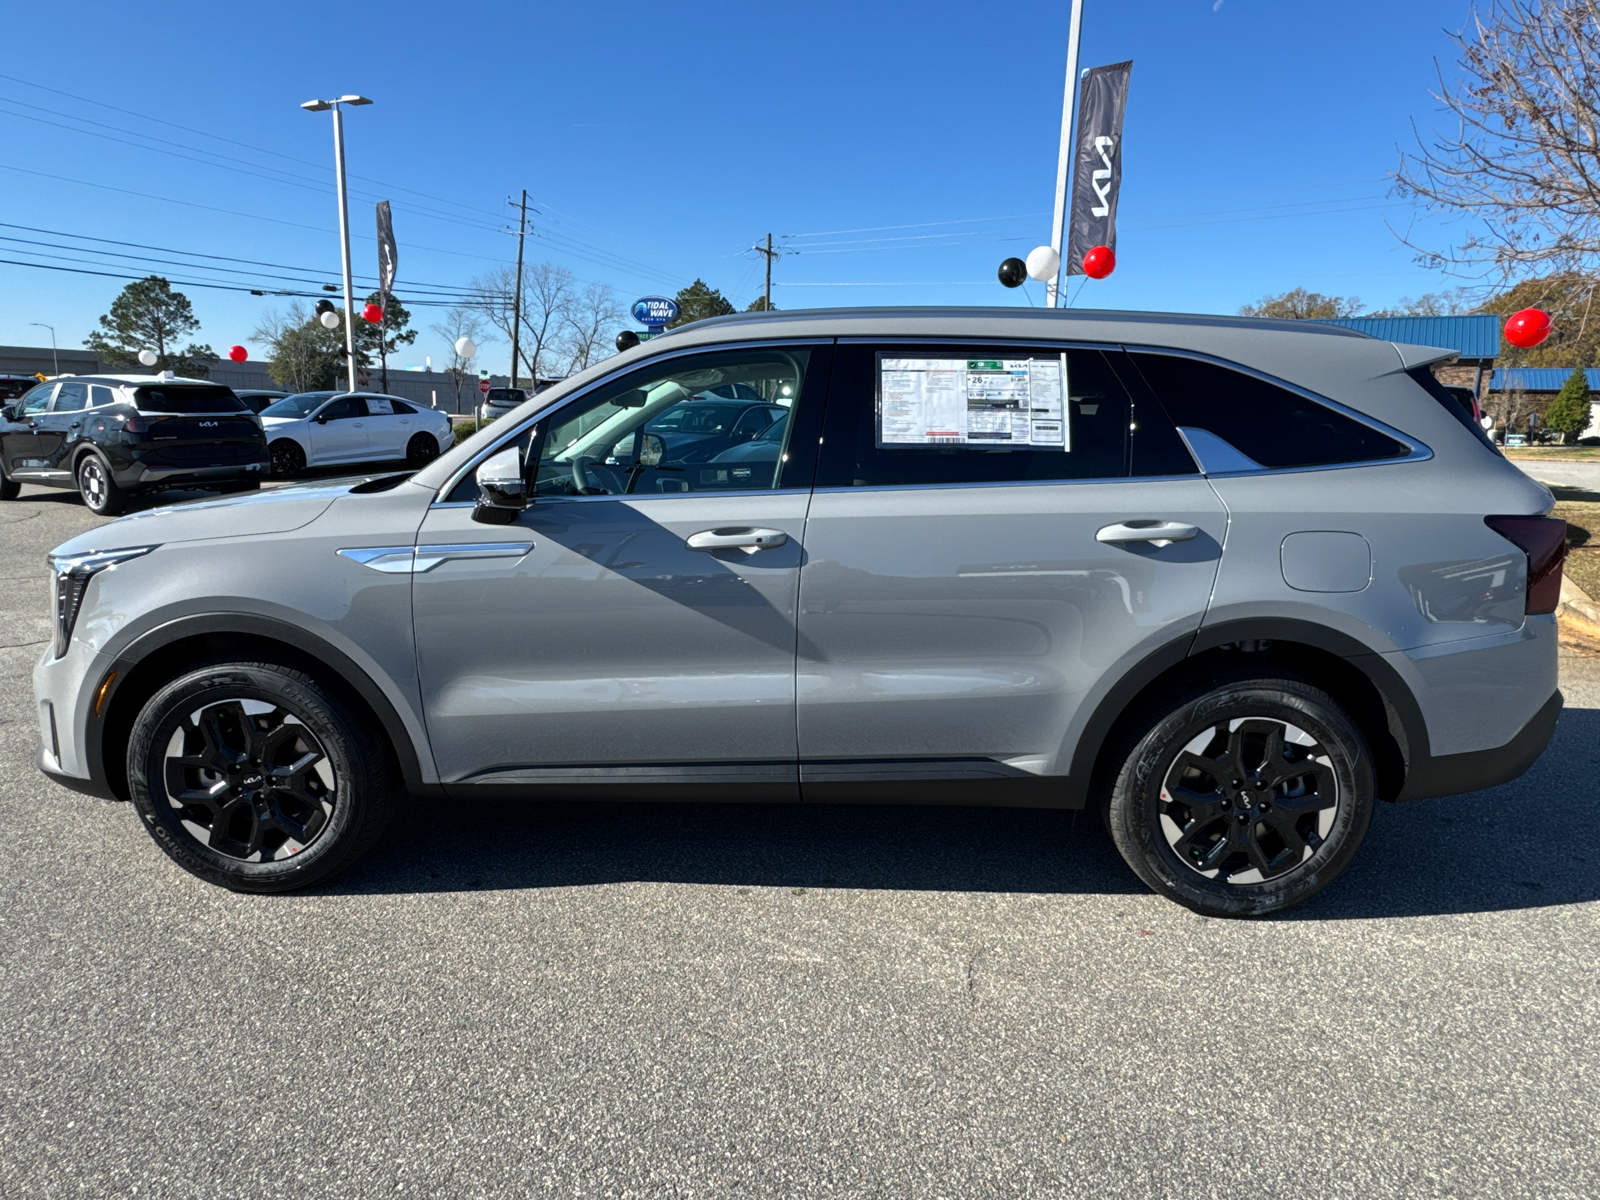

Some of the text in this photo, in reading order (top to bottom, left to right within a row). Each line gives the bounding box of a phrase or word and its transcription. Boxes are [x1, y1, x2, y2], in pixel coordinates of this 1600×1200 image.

[1091, 136, 1113, 217] KIA
[243, 775, 262, 784] KIA
[1240, 791, 1251, 809] KIA
